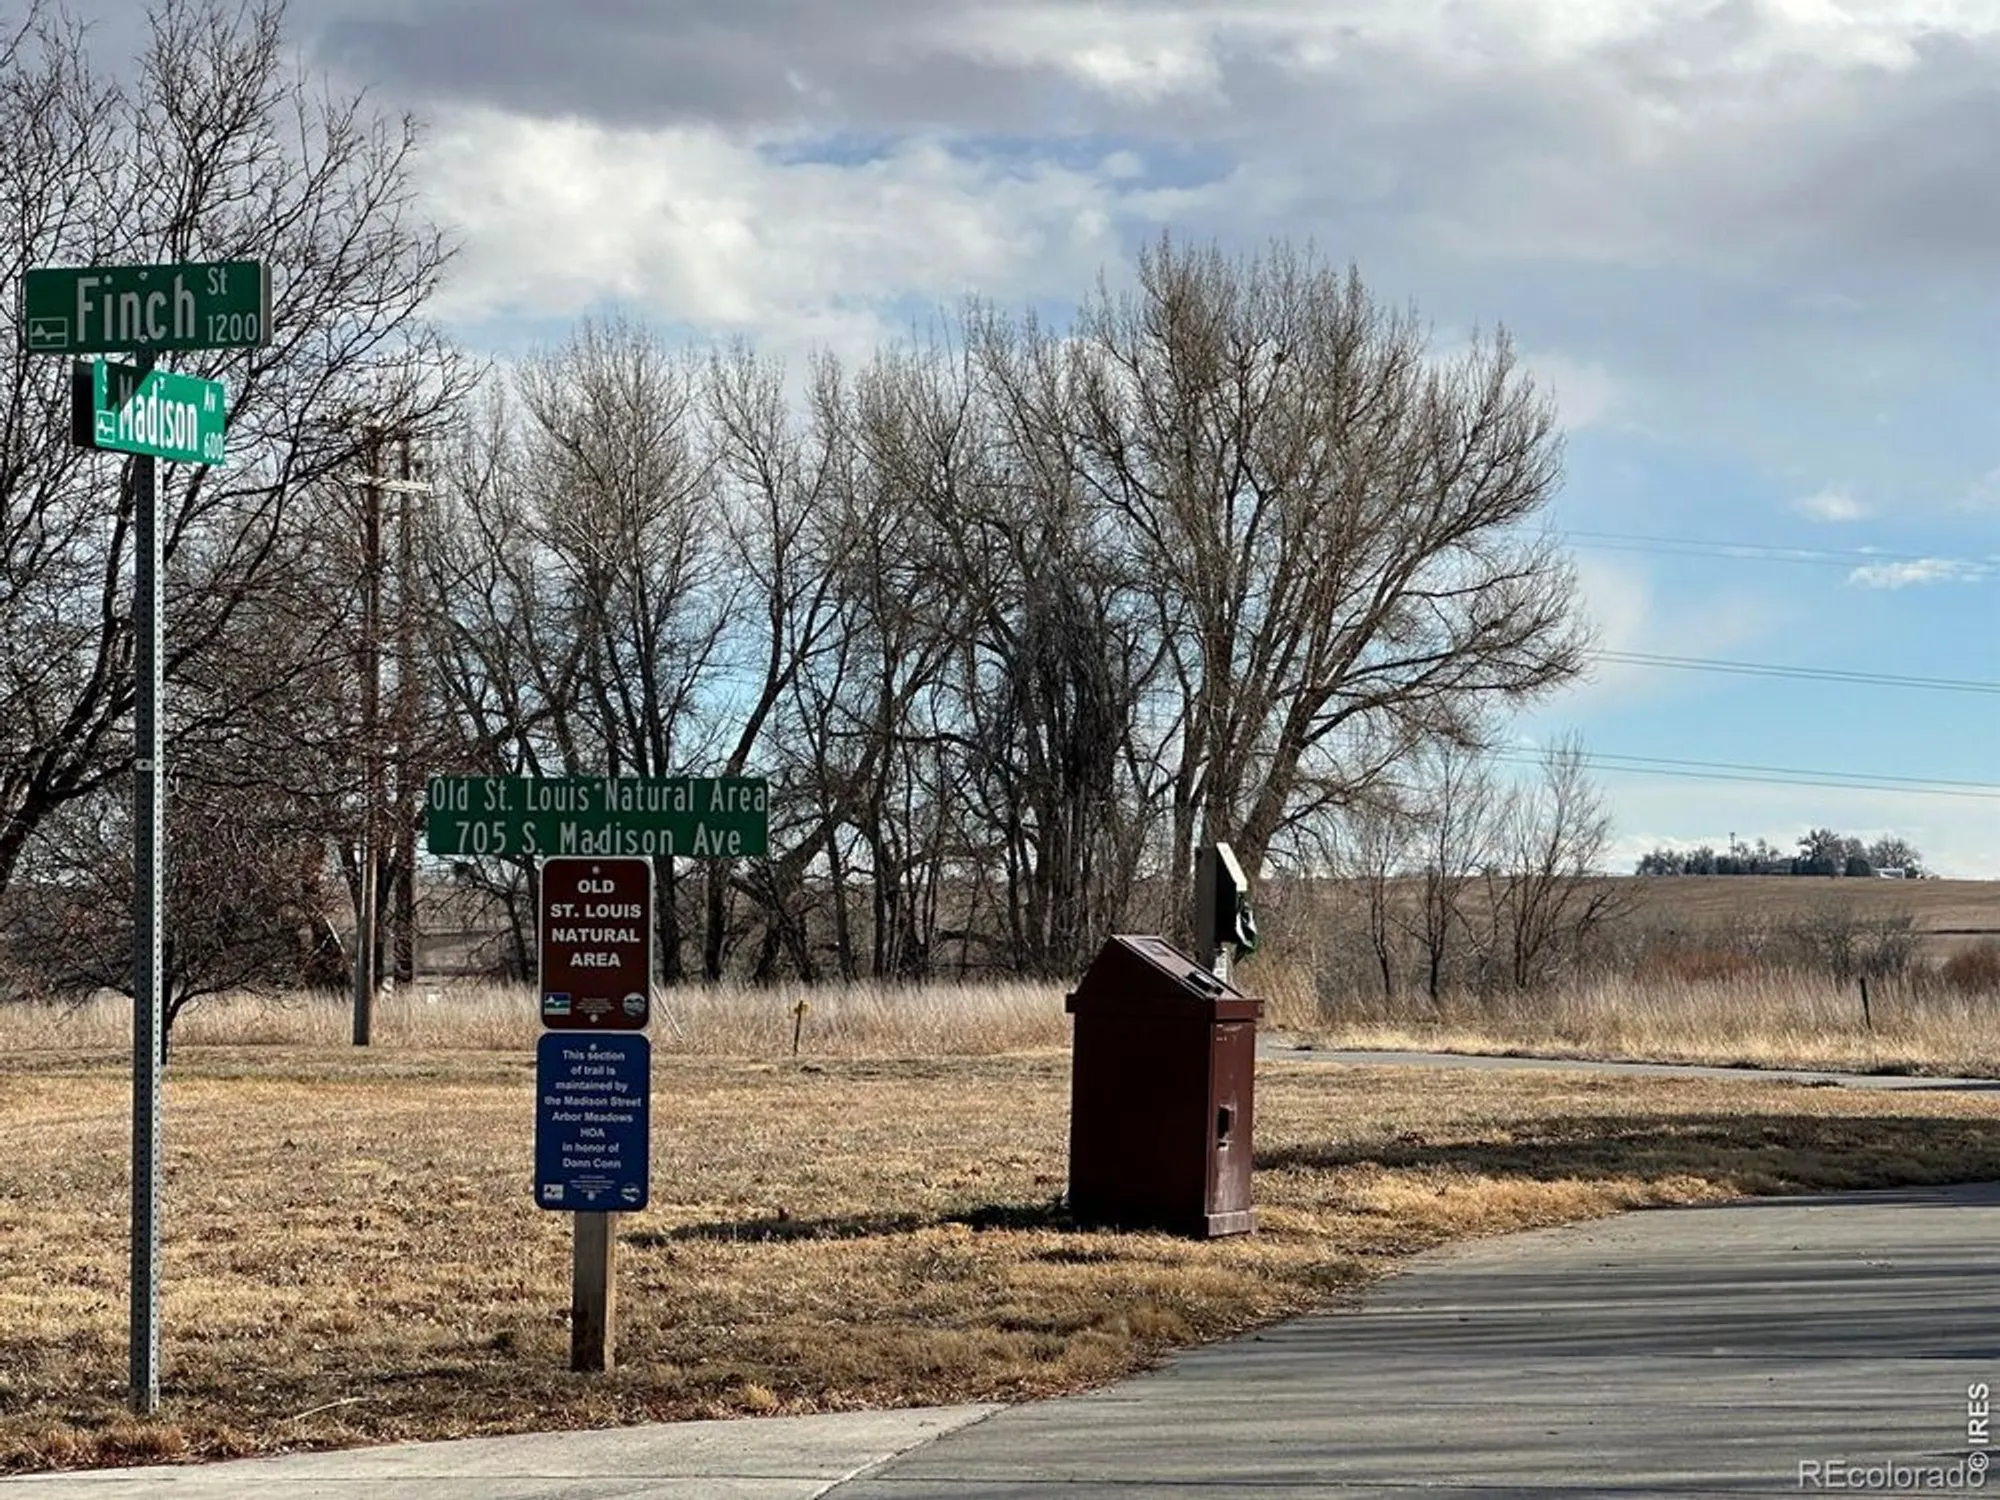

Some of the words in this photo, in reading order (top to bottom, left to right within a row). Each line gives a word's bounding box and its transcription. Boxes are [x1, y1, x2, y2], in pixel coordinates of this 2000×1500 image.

[76, 273, 196, 343] Finch
[206, 266, 229, 296] St
[207, 313, 258, 343] 1200
[119, 372, 198, 451] Madison
[203, 384, 217, 413] Av
[431, 779, 469, 812] Old
[484, 779, 514, 812] St.
[526, 779, 590, 812] Louis
[604, 779, 695, 812] Natural
[709, 779, 766, 812] Area
[456, 821, 507, 854] 705
[521, 821, 544, 854] S.
[559, 821, 674, 854] Madison
[692, 821, 742, 854] Ave
[577, 879, 615, 894] OLD
[550, 903, 580, 919] ST.
[585, 903, 642, 919] LOUIS
[551, 927, 641, 943] NATURAL
[569, 952, 621, 968] AREA
[562, 1050, 585, 1061] This
[587, 1050, 625, 1062] section
[570, 1065, 583, 1076] of
[584, 1065, 604, 1076] trail
[606, 1065, 616, 1076] is
[555, 1081, 613, 1092] maintained
[614, 1081, 628, 1094] by
[544, 1096, 561, 1106] the
[564, 1096, 608, 1107] Madison
[610, 1096, 641, 1108] Street
[552, 1111, 582, 1122] Arbor
[584, 1111, 633, 1123] Meadows
[580, 1127, 606, 1138] HOA
[562, 1142, 573, 1153] in
[574, 1142, 606, 1154] honor
[607, 1142, 620, 1154] of
